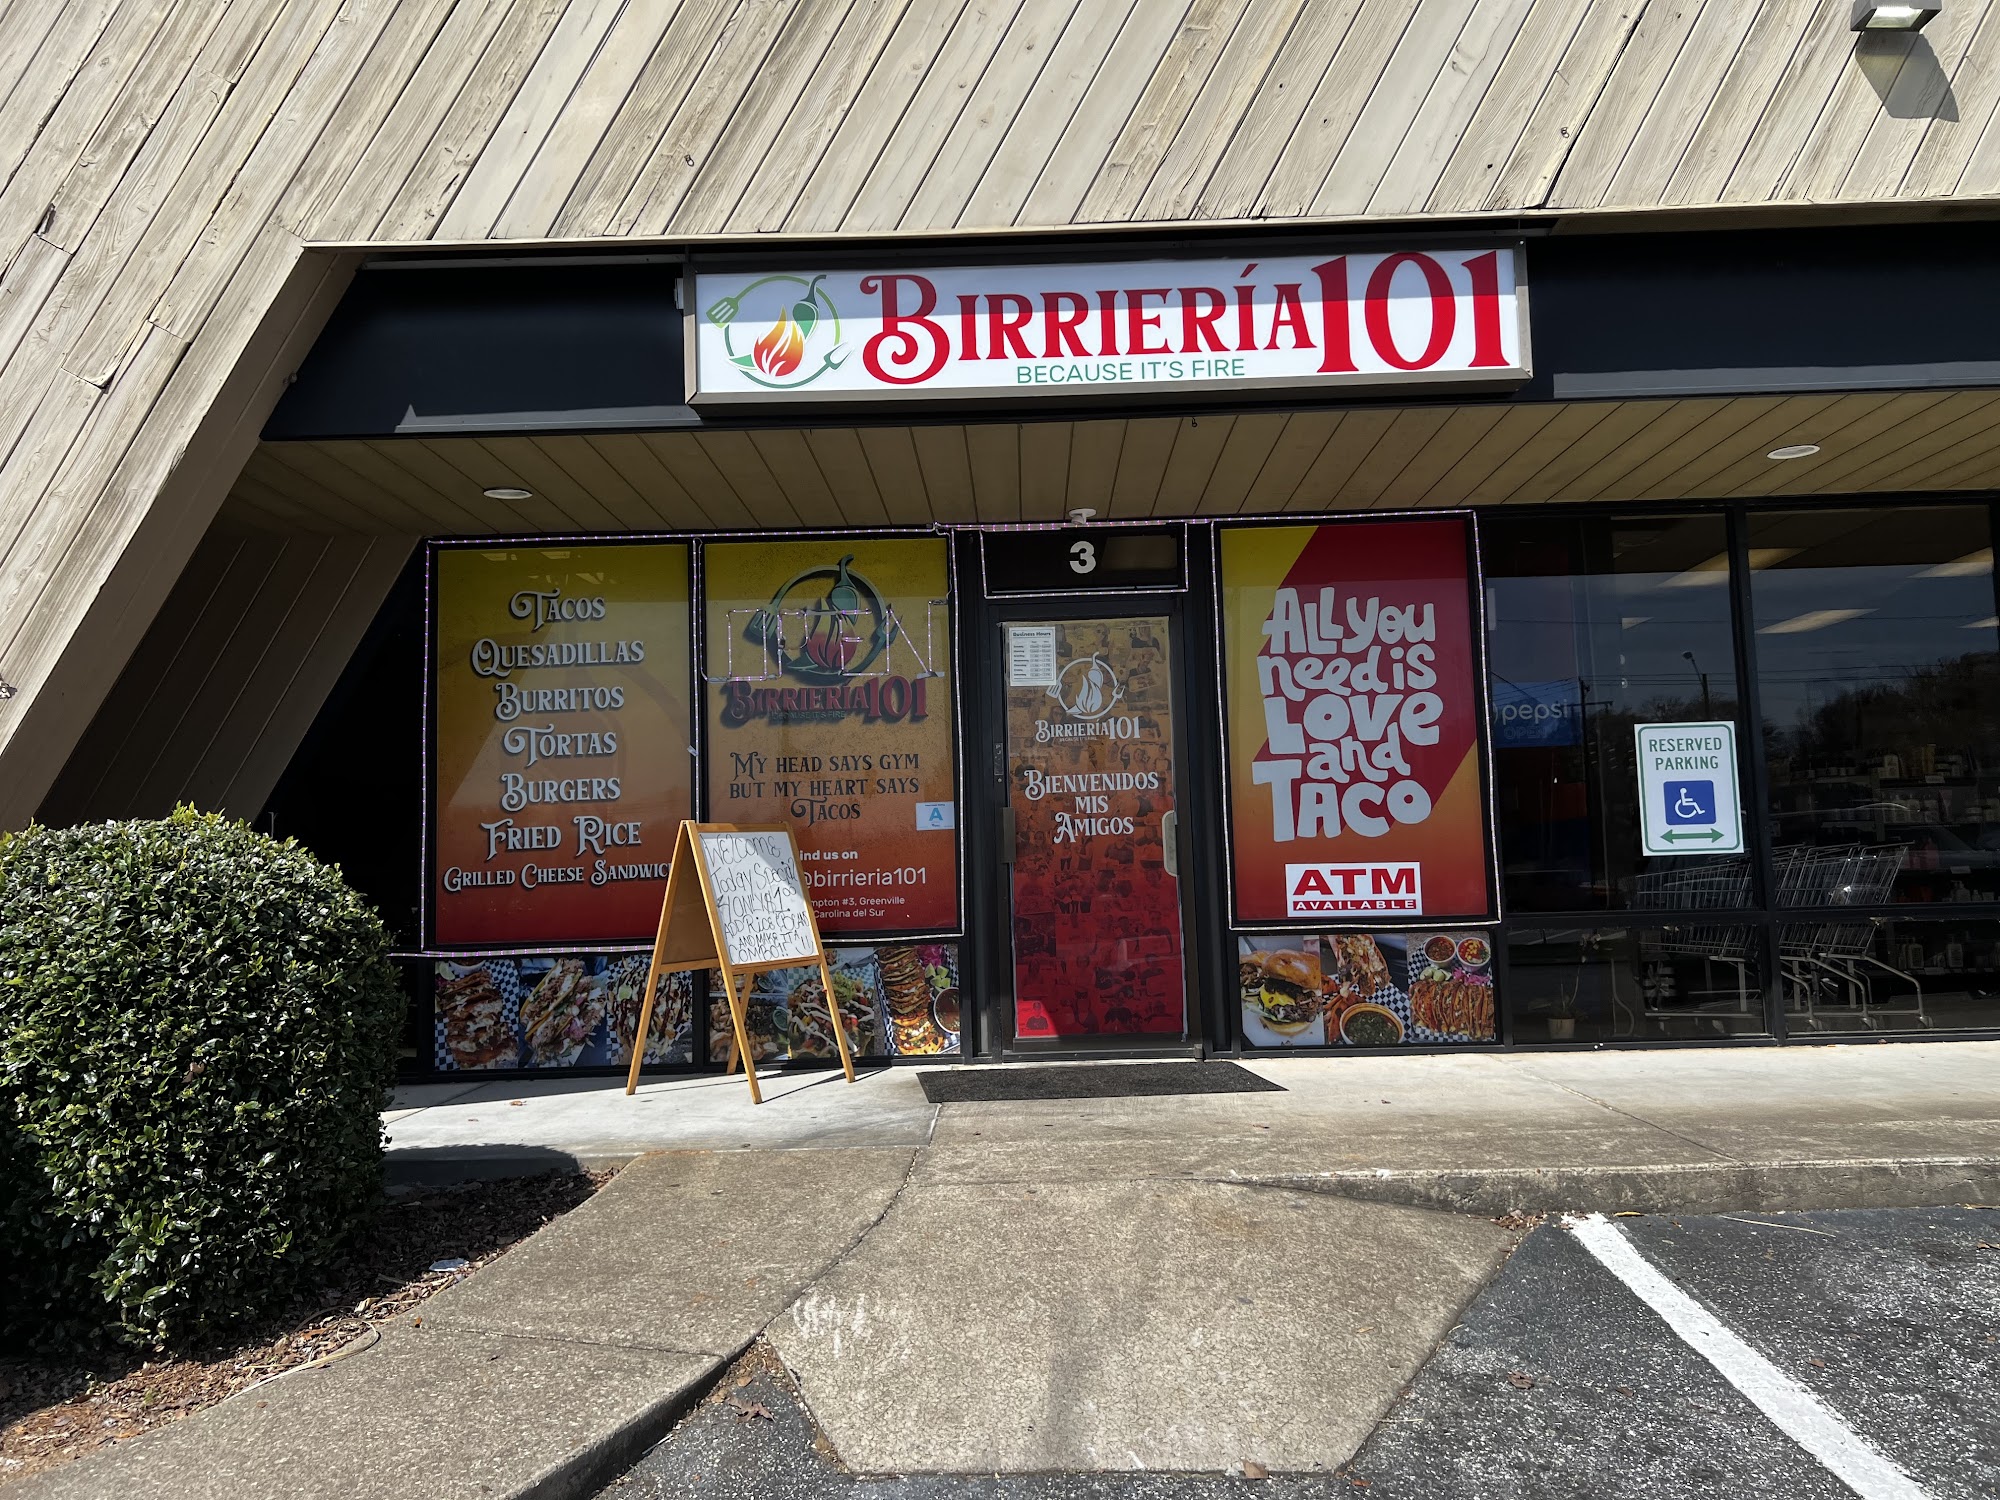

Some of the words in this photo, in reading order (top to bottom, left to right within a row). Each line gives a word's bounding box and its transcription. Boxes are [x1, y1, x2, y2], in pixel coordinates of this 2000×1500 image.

[1017, 362, 1133, 384] BECAUSE
[1141, 361, 1184, 379] IT'S
[1192, 358, 1246, 377] FIRE
[1069, 541, 1096, 574] 3
[510, 588, 606, 631] TACOS
[471, 638, 645, 677] QUESADILLAS
[1257, 645, 1388, 701] need
[1392, 643, 1437, 690] is
[494, 682, 625, 721] BURRITOS
[1502, 699, 1568, 726] pepsi
[503, 724, 617, 767] TORTAS
[1503, 726, 1548, 740] OPEN
[1649, 737, 1722, 752] RESERVED
[729, 751, 768, 781] MY
[775, 756, 823, 773] HEAD
[829, 755, 872, 772] SAYS
[879, 753, 919, 770] GYM
[1306, 721, 1411, 784] and
[1655, 755, 1719, 771] PARKING
[501, 773, 621, 812] BURGERS
[729, 782, 766, 799] BUT
[773, 781, 803, 797] MY
[810, 779, 869, 796] HEART
[876, 777, 919, 794] SAYS
[1023, 770, 1159, 800] BIENVENIDOS
[790, 797, 861, 828] TACOS
[929, 807, 944, 821] A
[1075, 796, 1109, 814] MIS
[480, 819, 562, 861] FRIED
[573, 815, 643, 856] RICE
[1053, 812, 1135, 844] AMIGOS
[799, 850, 821, 860] ind
[823, 851, 839, 860] us
[841, 850, 859, 860] on
[443, 866, 516, 893] GRILLED
[520, 863, 585, 889] CHEESE
[590, 859, 672, 886] SANDWIC
[1293, 868, 1416, 896] ATM
[852, 909, 867, 917] del
[869, 908, 885, 916] Sur
[859, 896, 906, 905] Greenville
[1296, 900, 1415, 910] AVAILABLE
